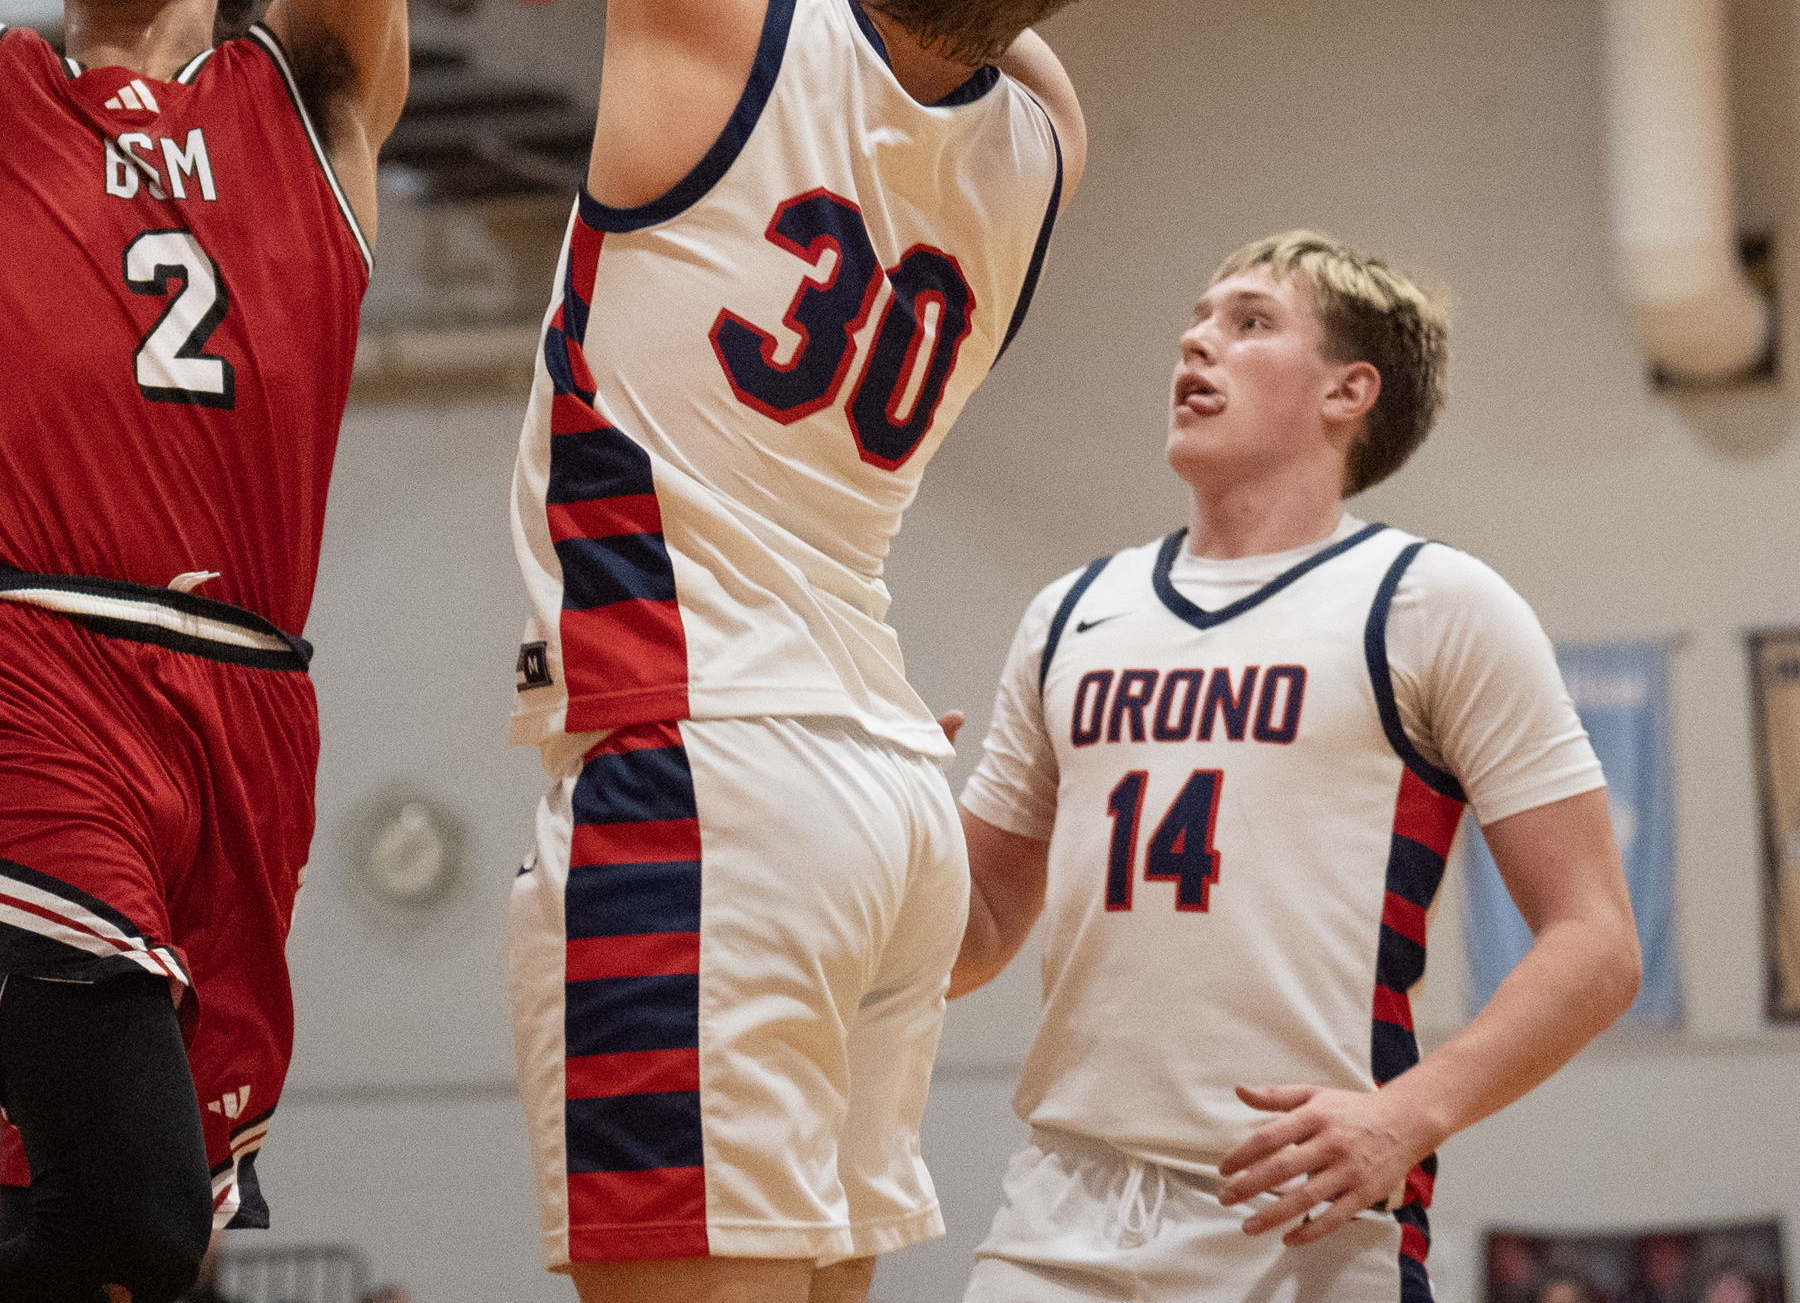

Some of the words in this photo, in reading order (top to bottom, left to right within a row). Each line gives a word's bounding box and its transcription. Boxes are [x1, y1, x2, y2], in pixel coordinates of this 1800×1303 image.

[104, 128, 217, 201] BSM
[122, 228, 236, 411] 2
[708, 186, 976, 472] 30
[1071, 664, 1308, 748] ORONO
[1104, 768, 1224, 914] 14
